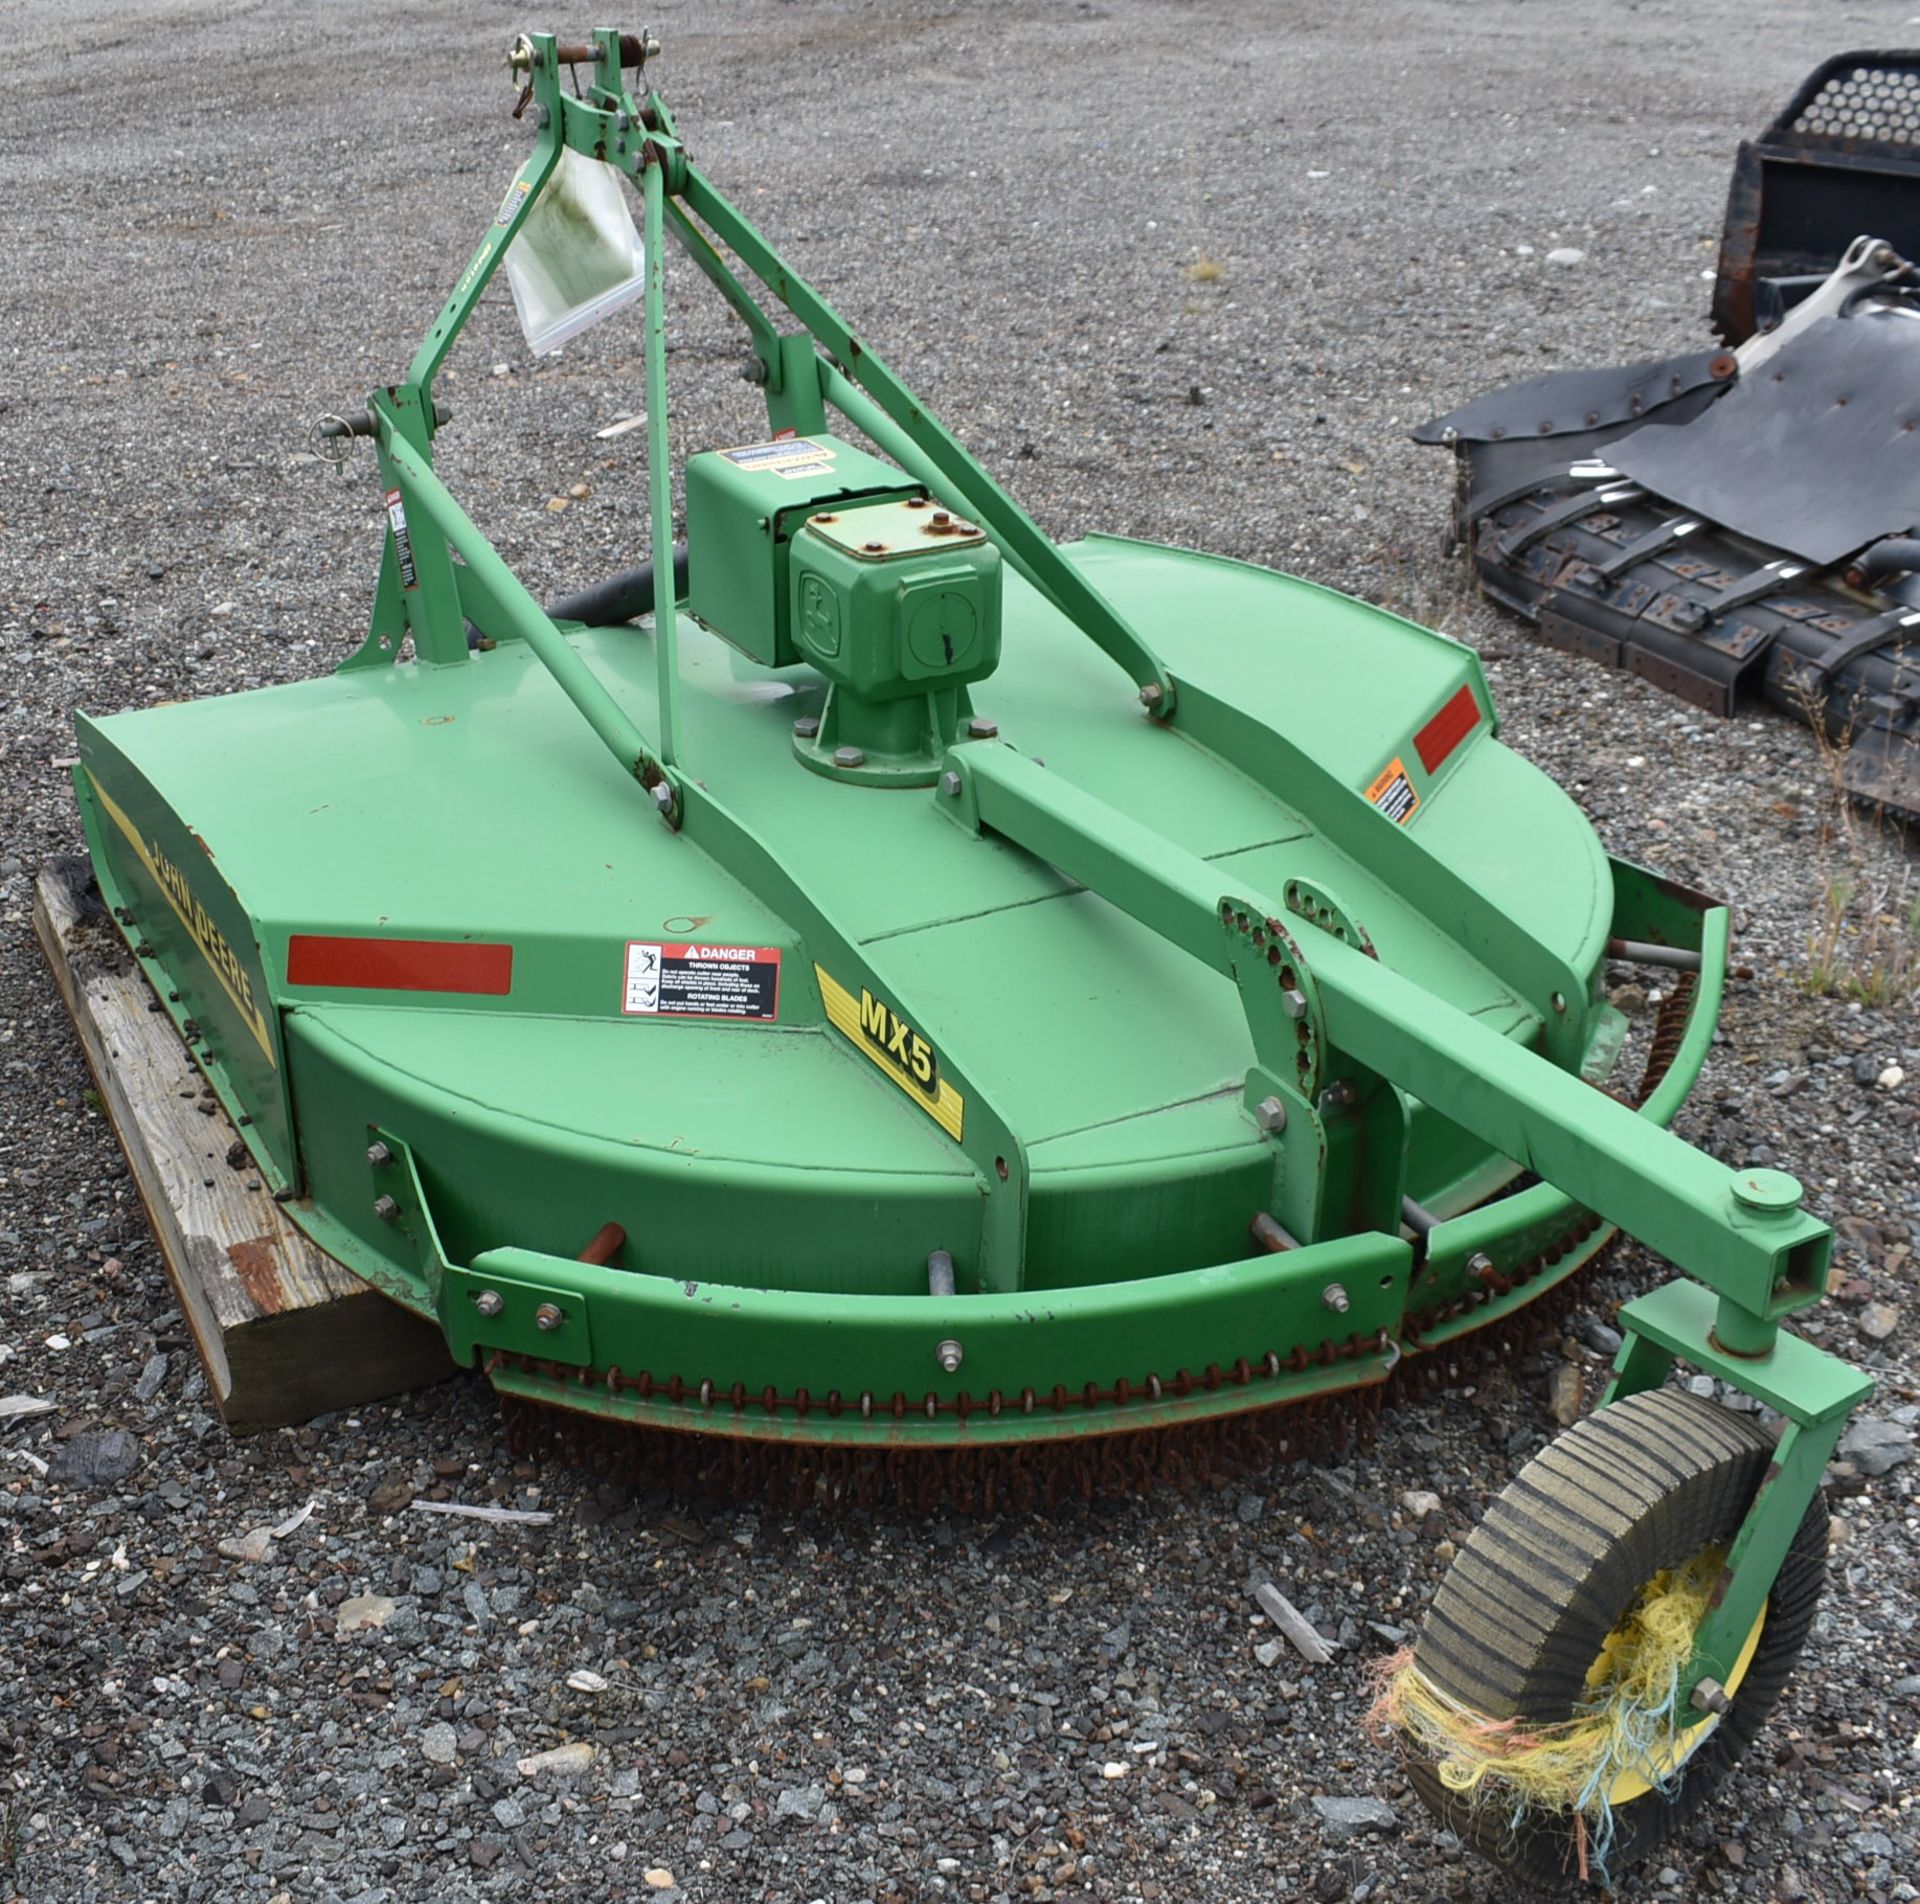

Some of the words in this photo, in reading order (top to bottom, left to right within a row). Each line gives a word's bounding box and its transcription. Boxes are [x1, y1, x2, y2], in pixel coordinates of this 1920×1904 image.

[153, 837, 193, 922] JOHN
[194, 898, 254, 1011] DEERE
[700, 947, 756, 961] DANGER
[688, 961, 719, 971] THROWN
[719, 963, 750, 972] OBJECTS
[686, 992, 721, 1001] ROTATING
[721, 994, 748, 1003] BLADES
[859, 985, 937, 1092] MX5
